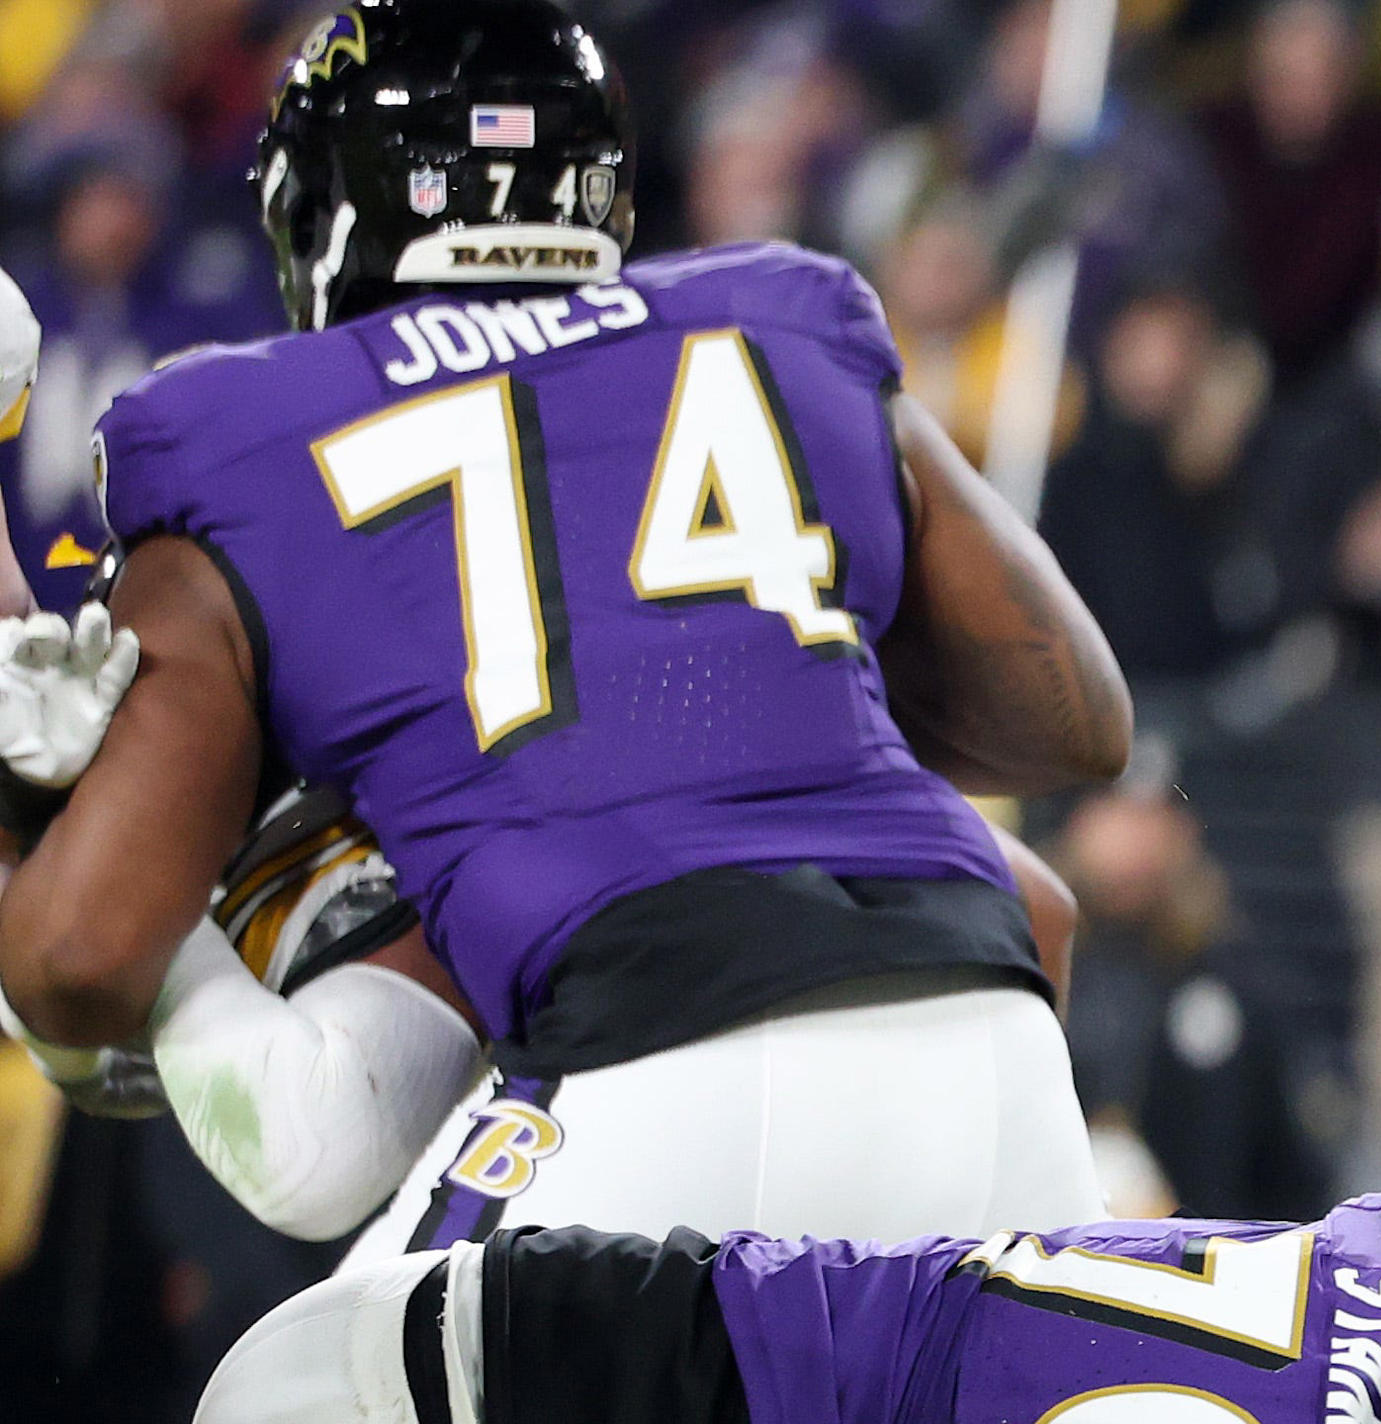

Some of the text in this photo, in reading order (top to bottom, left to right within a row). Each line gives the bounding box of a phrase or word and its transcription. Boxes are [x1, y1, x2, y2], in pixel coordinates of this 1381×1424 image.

[385, 284, 649, 386] JONES
[310, 327, 860, 755] 74
[440, 1098, 566, 1199] B
